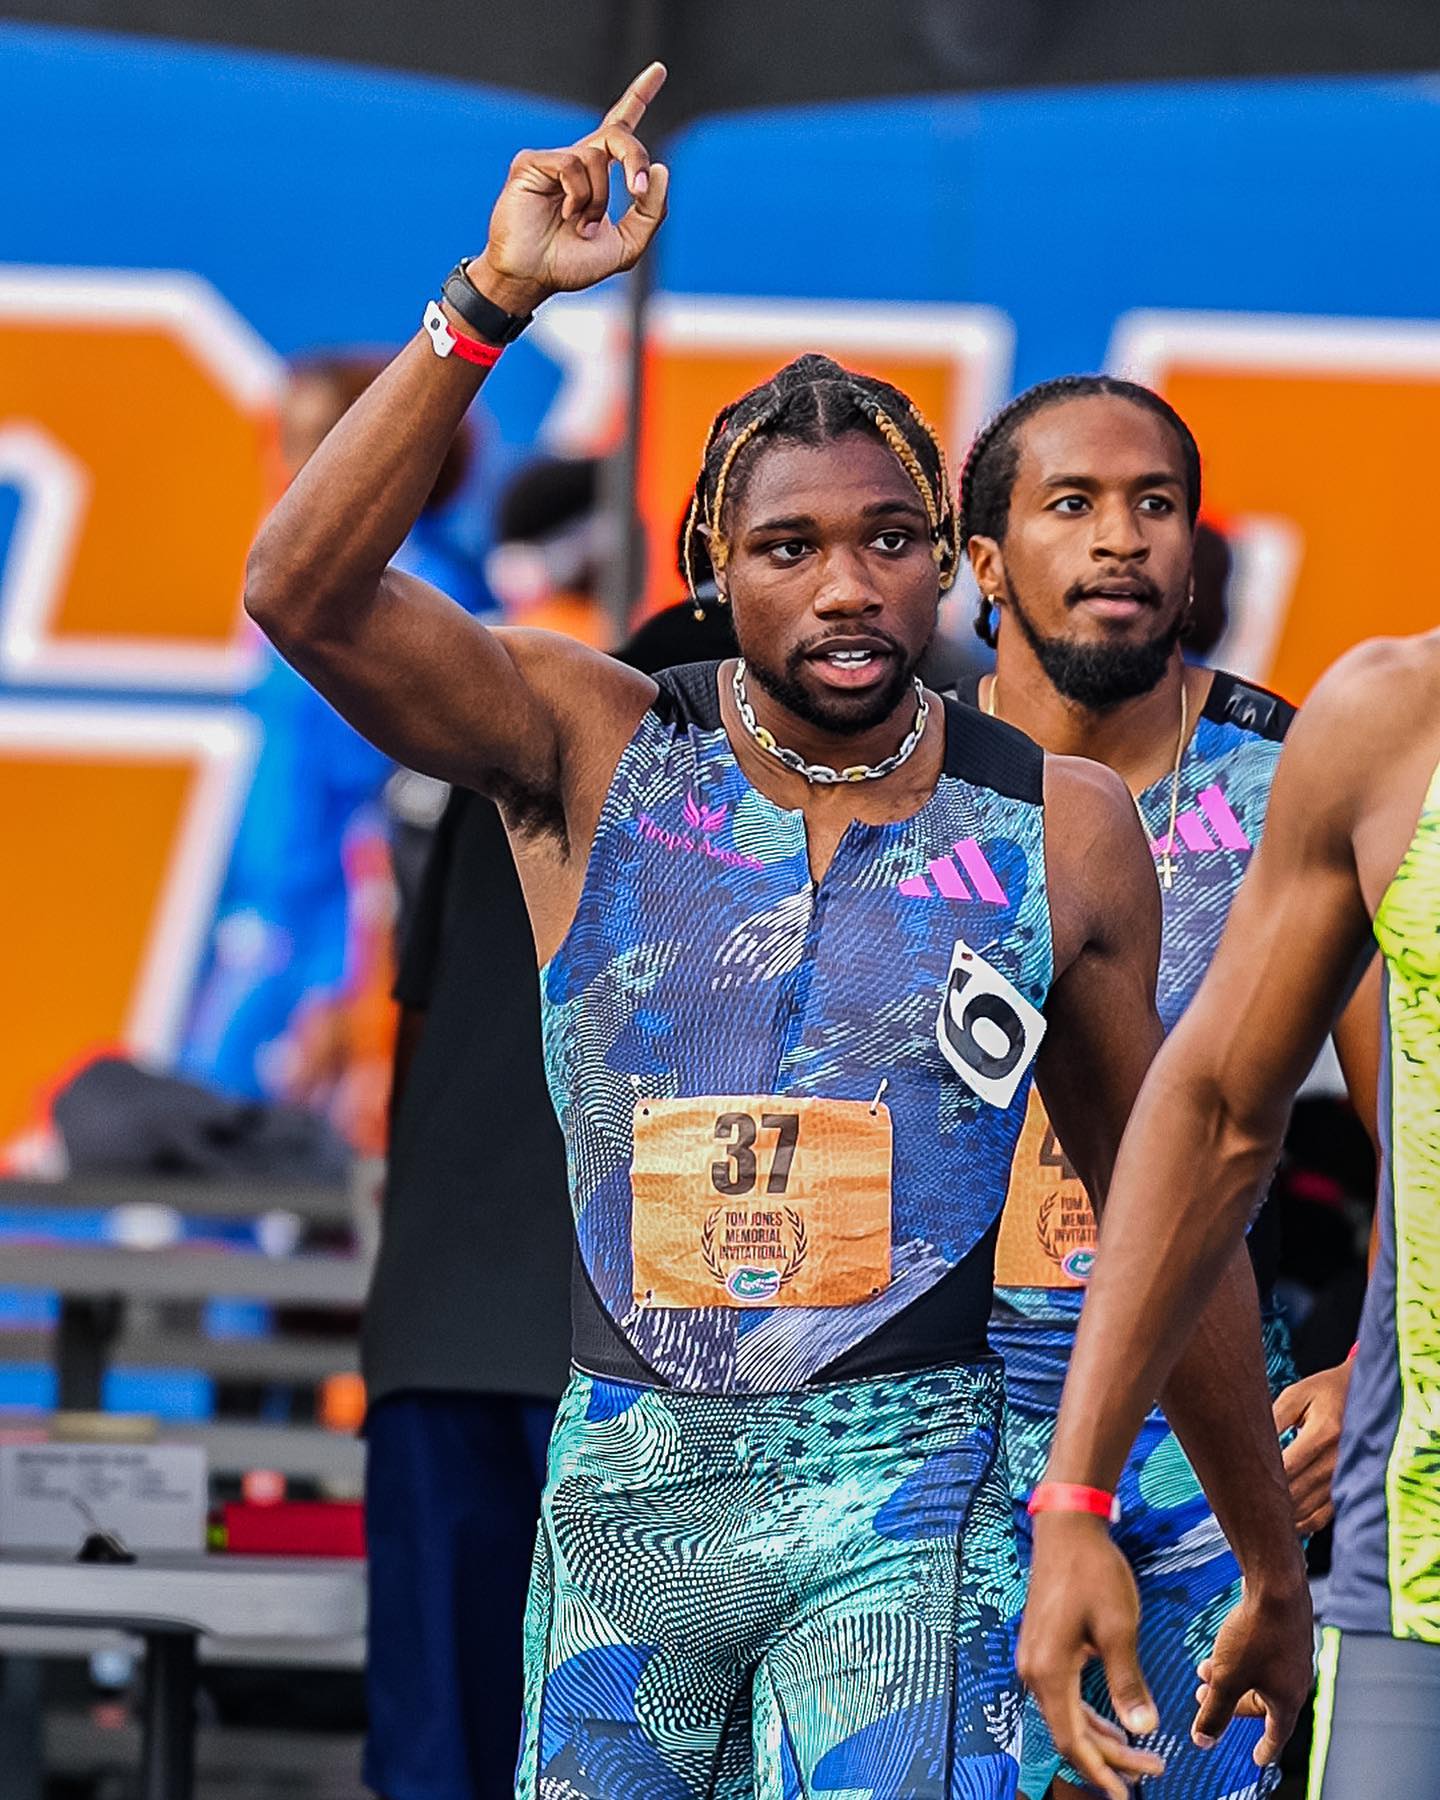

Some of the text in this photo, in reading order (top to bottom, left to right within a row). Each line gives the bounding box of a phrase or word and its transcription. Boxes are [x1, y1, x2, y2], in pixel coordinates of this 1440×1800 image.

[943, 967, 1026, 1081] 6
[711, 1111, 800, 1196] 37
[1061, 1196, 1082, 1211] TOM
[725, 1211, 783, 1227] TOM JONES
[726, 1228, 782, 1244] MEMORIAL
[720, 1244, 788, 1260] INVITATIONAL
